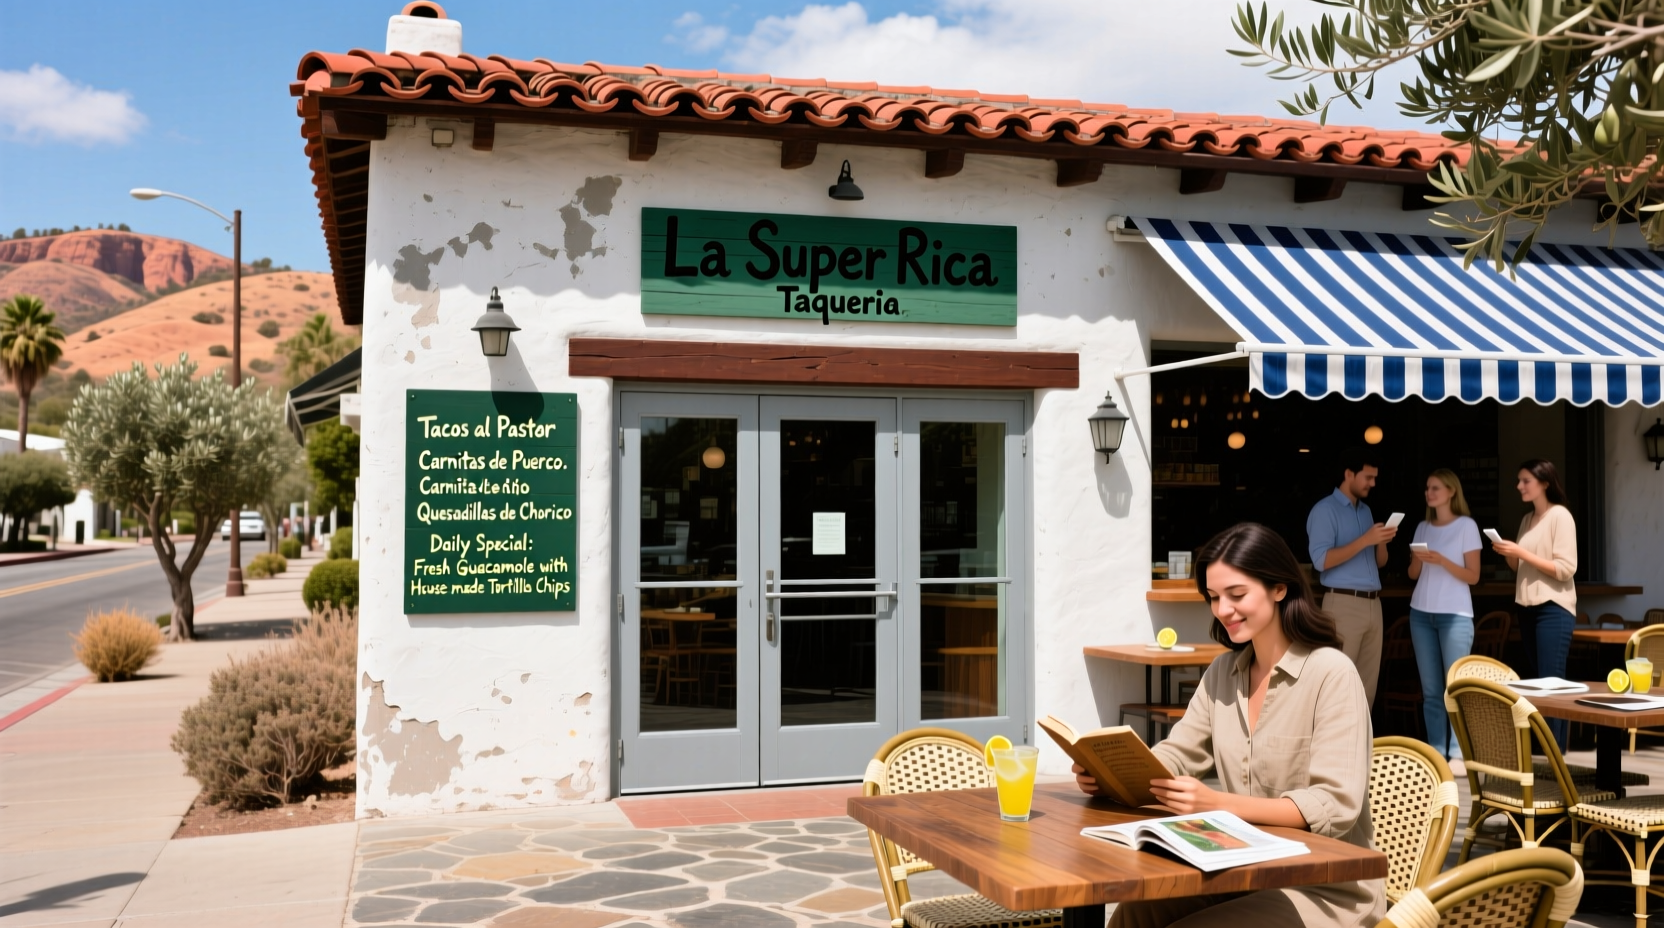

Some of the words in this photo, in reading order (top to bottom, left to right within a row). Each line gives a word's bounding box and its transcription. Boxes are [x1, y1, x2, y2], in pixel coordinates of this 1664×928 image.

[664, 215, 731, 278] La
[746, 219, 887, 294] Super
[897, 227, 998, 287] Rica
[416, 414, 470, 439] Tacos
[473, 415, 491, 438] al
[497, 414, 557, 439] Pastor
[418, 449, 486, 471] Carnitas
[488, 449, 508, 470] de
[511, 449, 568, 471] Puerco.
[416, 501, 497, 526] Quesadillas
[499, 502, 517, 521] de
[430, 533, 471, 559] Daily
[475, 532, 534, 560] Special:
[413, 557, 451, 576] Fresh
[539, 555, 568, 573] with
[535, 575, 571, 600] Chips
